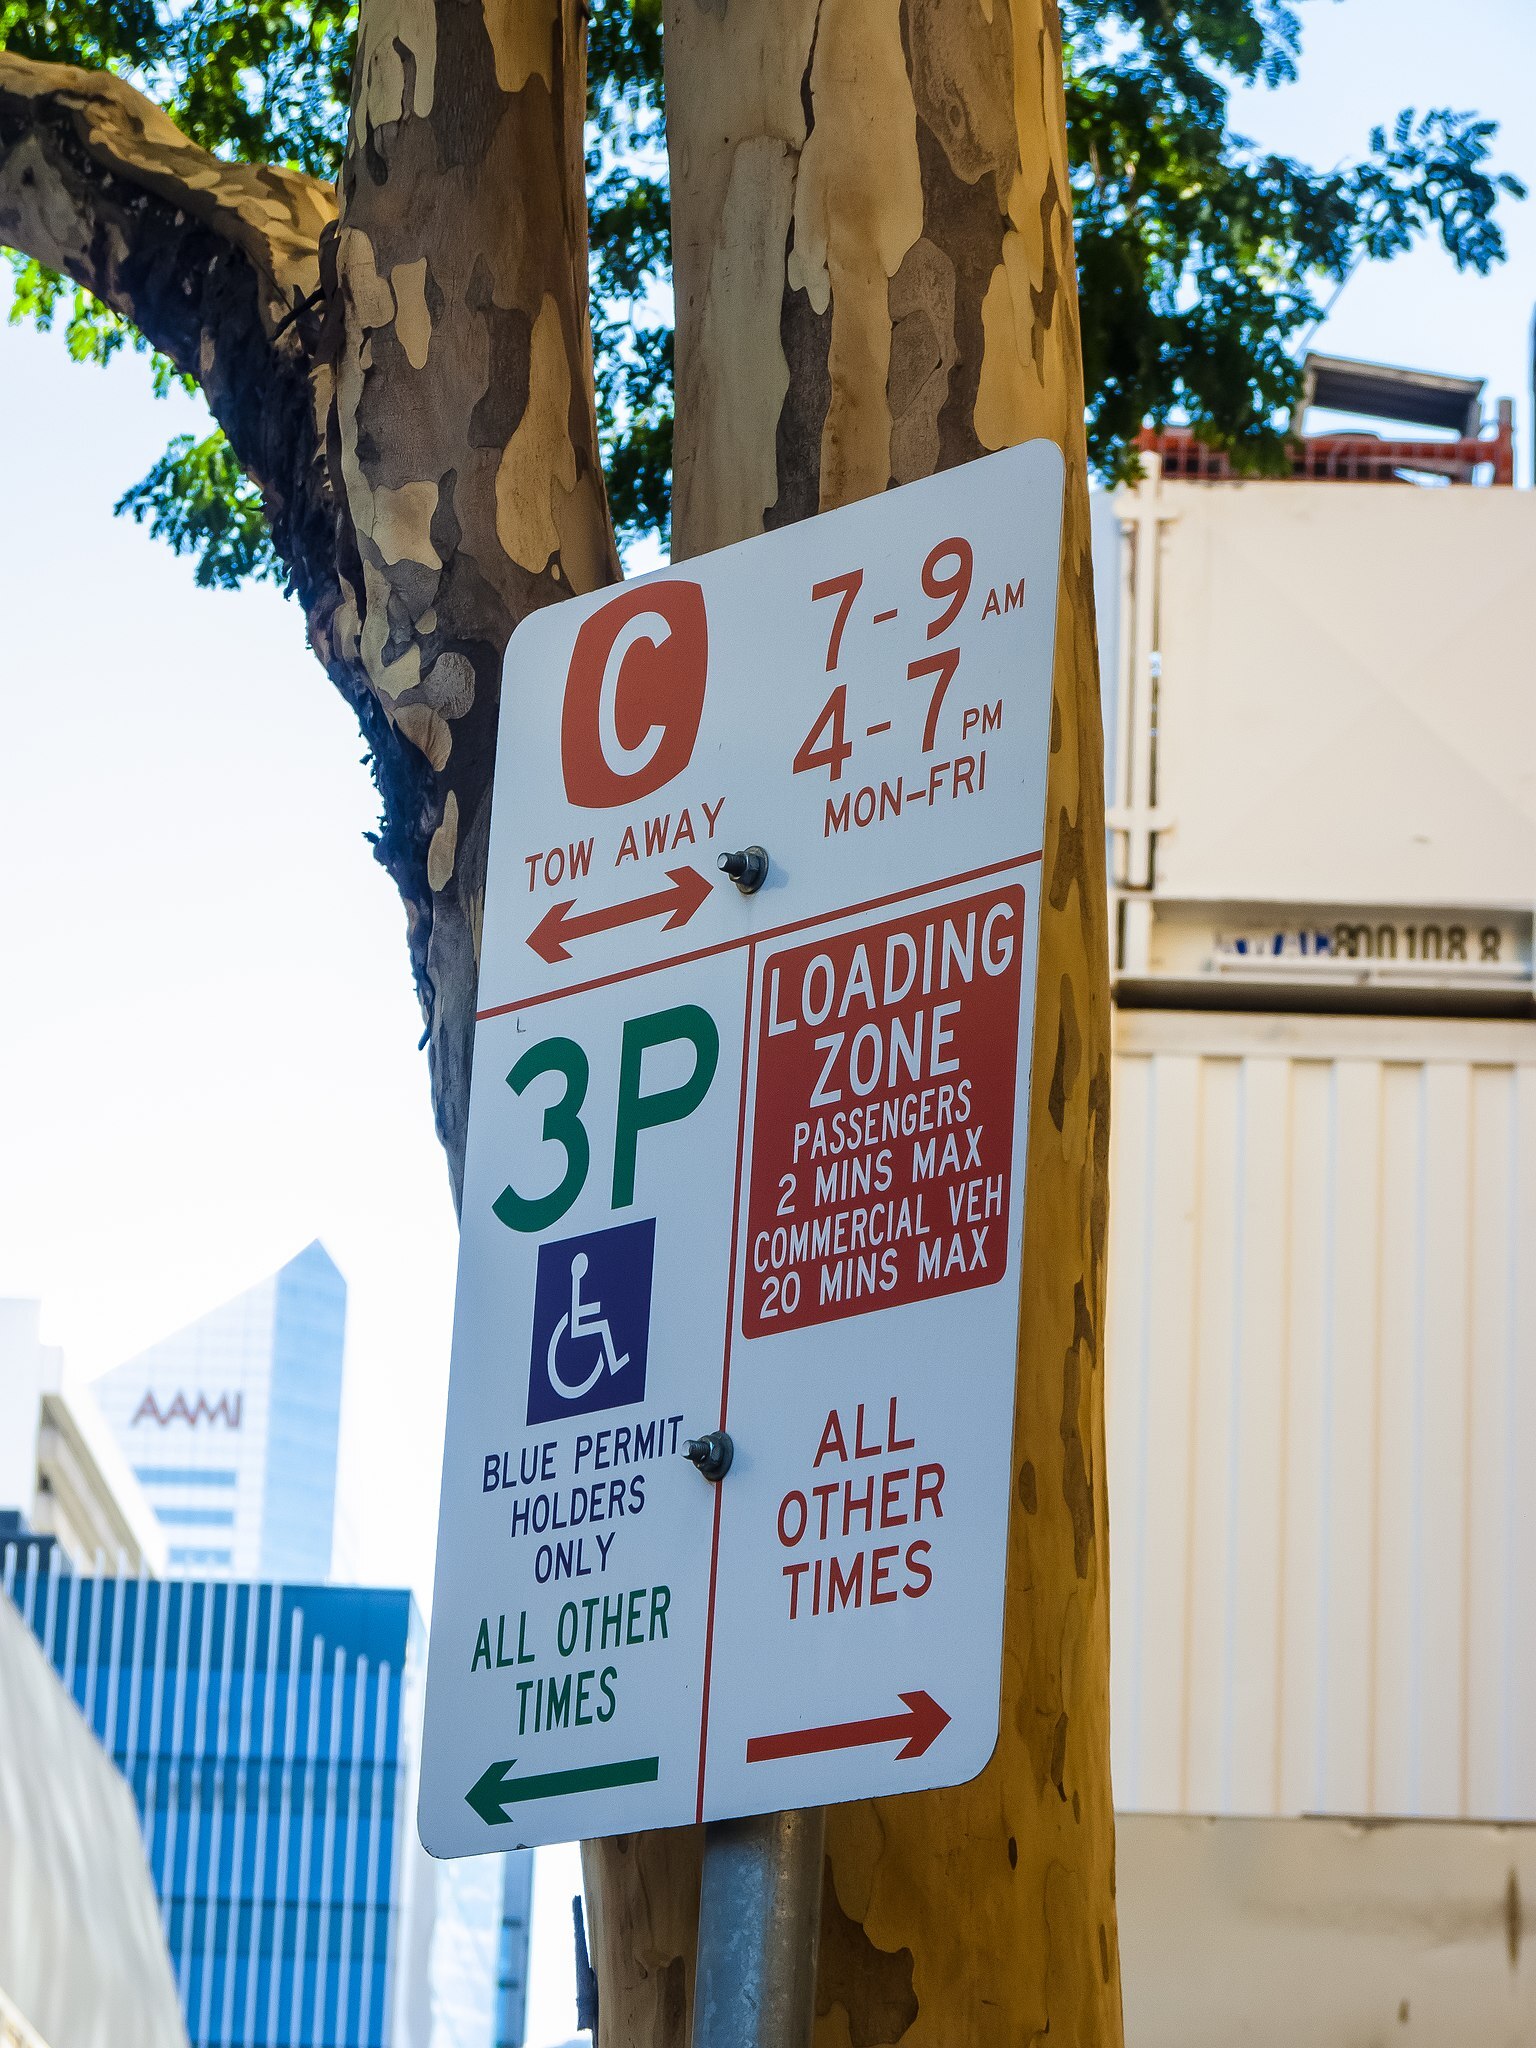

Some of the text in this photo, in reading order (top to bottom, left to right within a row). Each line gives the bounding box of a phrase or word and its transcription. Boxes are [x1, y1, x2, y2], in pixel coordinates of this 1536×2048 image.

[981, 578, 1025, 621] AM
[599, 611, 672, 776] C
[962, 700, 1002, 740] PM
[824, 751, 986, 838] MON-FRI
[524, 797, 725, 892] TOW AWAY
[767, 902, 1014, 1037] LOADING
[810, 1001, 961, 1109] ZONE
[491, 1004, 720, 1233] 3P
[793, 1079, 971, 1163] PASSENGERS
[776, 1126, 983, 1216] 2 MINS MAX
[754, 1174, 1002, 1273] COMMERCIAL VEH
[759, 1226, 989, 1319] 20 MINS MAX
[130, 1388, 243, 1430] AAMI
[813, 1396, 915, 1468] ALL
[482, 1415, 684, 1493] BLUE PERMIT
[511, 1475, 646, 1537] HOLDERS
[777, 1462, 945, 1548] OTHER
[534, 1532, 616, 1584] ONLY
[782, 1539, 933, 1620] TIMES
[470, 1585, 671, 1673] ALL OTHER
[515, 1665, 617, 1736] TIMES
